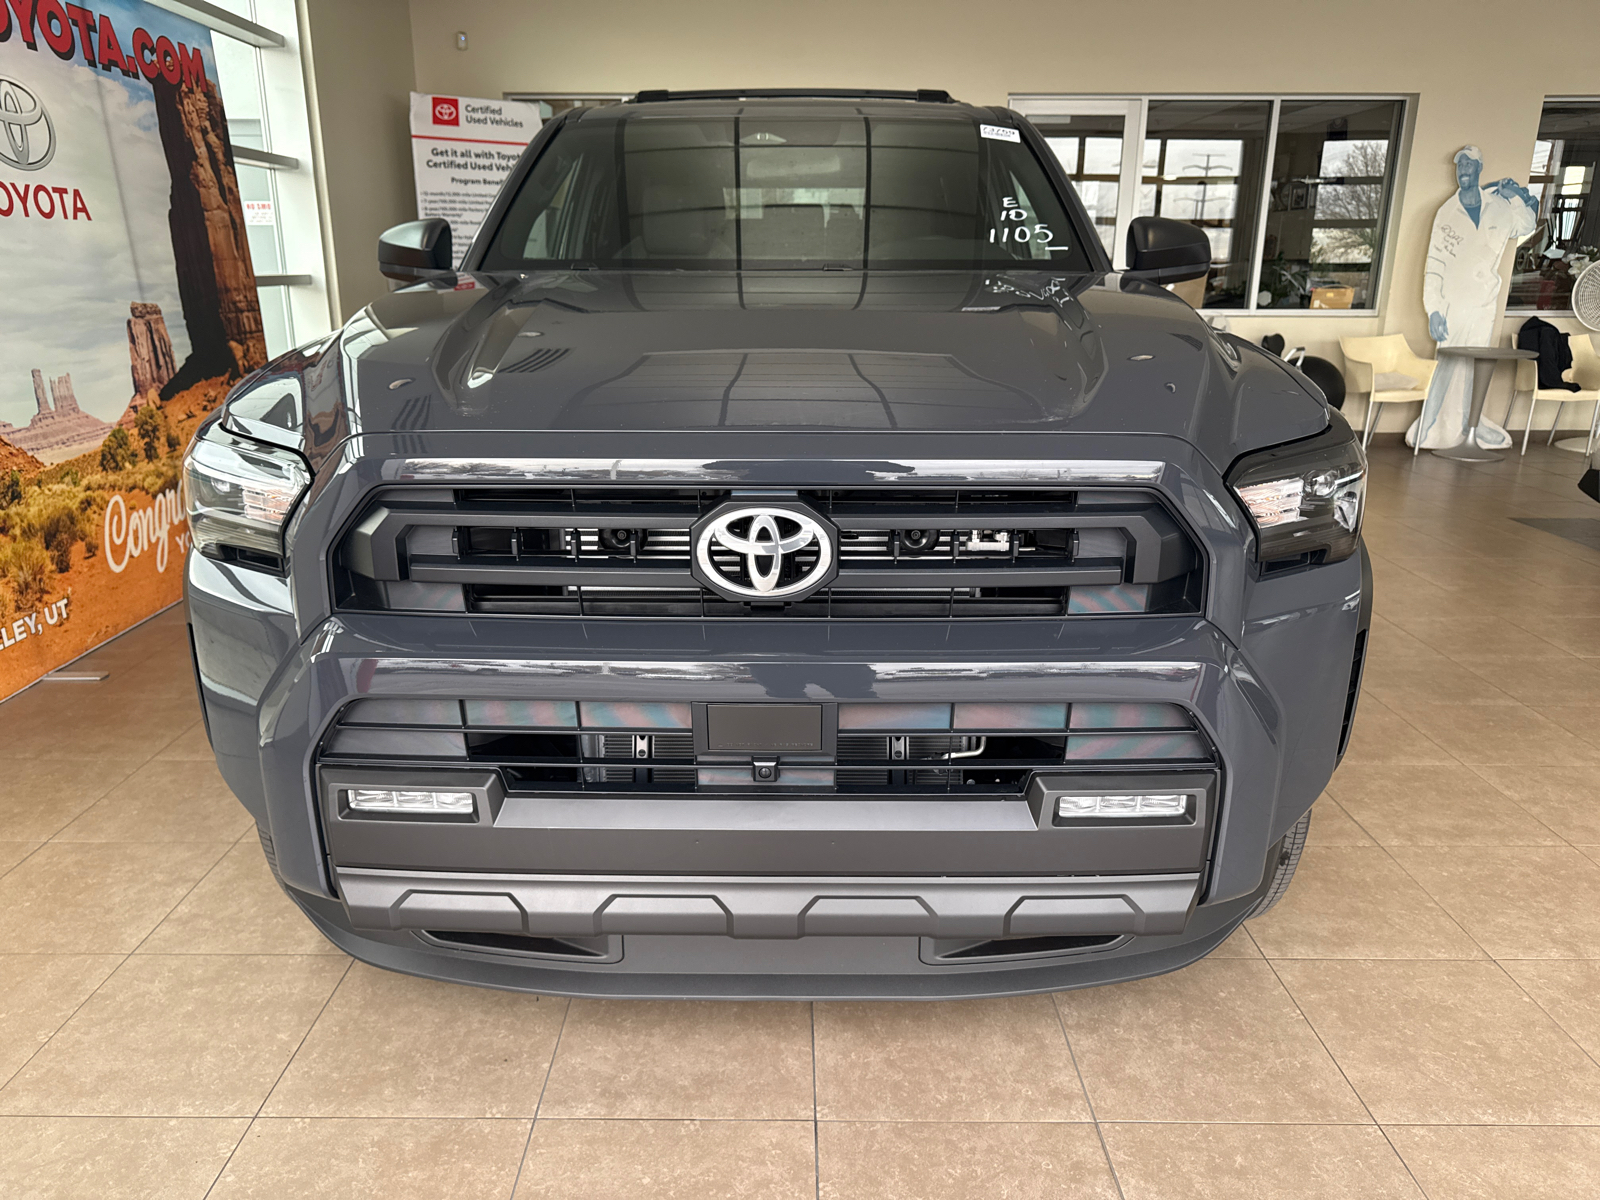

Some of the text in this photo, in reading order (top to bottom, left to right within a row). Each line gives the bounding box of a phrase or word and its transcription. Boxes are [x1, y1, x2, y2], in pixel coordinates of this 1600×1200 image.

[0, 0, 209, 94] YOTA.COM
[465, 104, 503, 116] Certified
[465, 115, 524, 128] Used Vehicles
[431, 148, 522, 163] Get it all with Toyot
[426, 160, 516, 173] Certified Used Veh
[451, 177, 506, 187] Program Benef
[0, 181, 92, 222] OYOTA
[0, 598, 68, 651] LEY, UT
